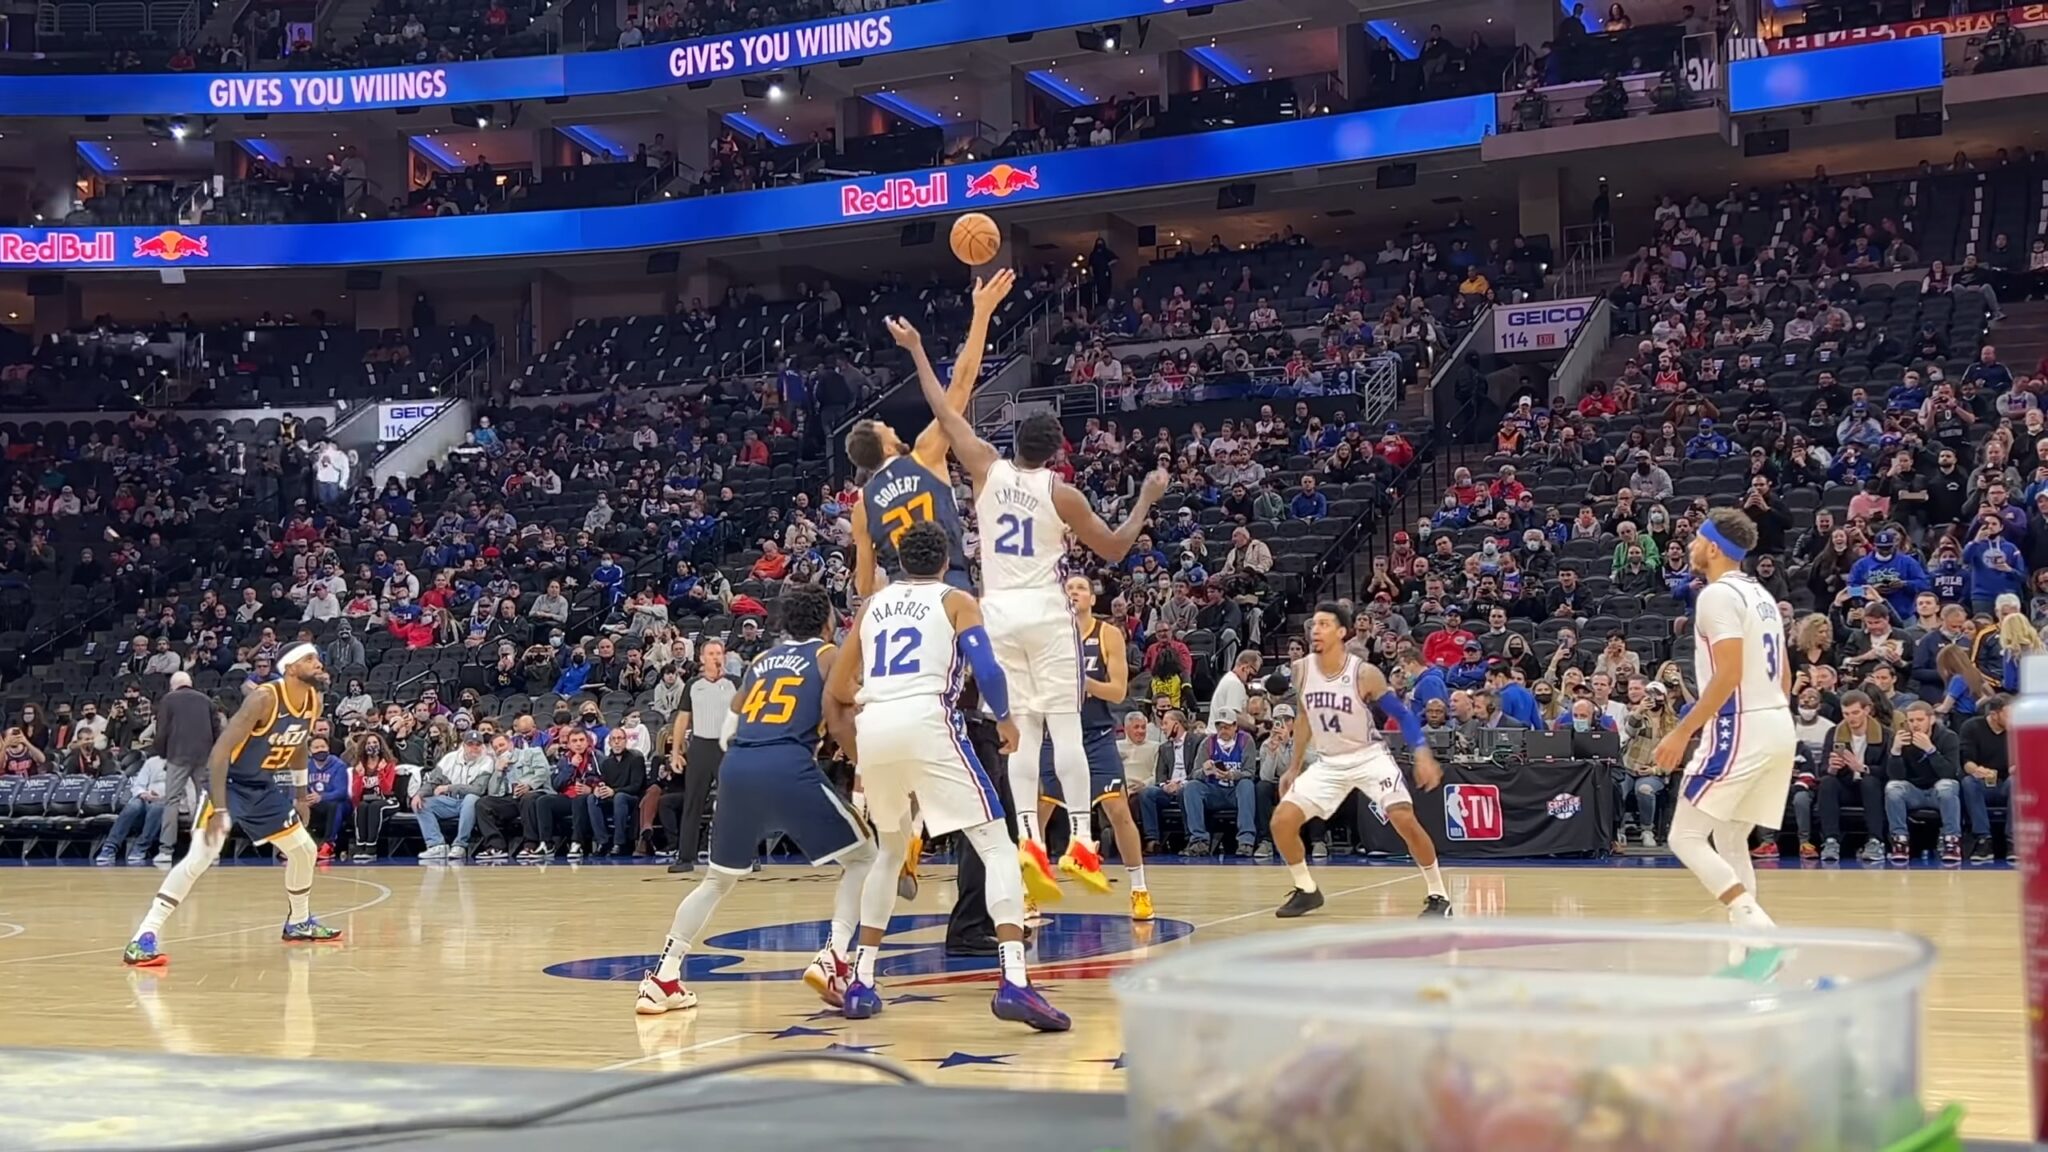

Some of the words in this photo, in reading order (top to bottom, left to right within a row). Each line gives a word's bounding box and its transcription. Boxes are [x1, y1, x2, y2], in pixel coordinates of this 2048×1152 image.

[669, 40, 735, 77] GIVES
[740, 32, 791, 66] YOU
[796, 16, 893, 58] WIIINGS
[209, 79, 283, 107] GIVES
[290, 77, 343, 105] YOU
[351, 70, 447, 103] WIIINGS
[842, 179, 895, 216] Red
[896, 172, 948, 210] Bull
[0, 233, 57, 263] Red
[59, 232, 115, 262] Bull
[1508, 307, 1584, 326] GEICO
[1501, 332, 1529, 349] 114
[390, 406, 438, 419] GEIC
[385, 424, 406, 438] 116
[874, 475, 921, 508] GOBERT
[882, 490, 934, 549] 27
[994, 513, 1035, 557] 21
[872, 601, 930, 624] HARRIS
[870, 626, 923, 678] 12
[753, 654, 812, 678] MITCHELL
[741, 676, 804, 724] 45
[1305, 691, 1353, 714] PHILA
[1320, 714, 1342, 733] 14
[261, 746, 296, 769] 23
[1379, 777, 1392, 792] 76
[1468, 795, 1494, 829] TV
